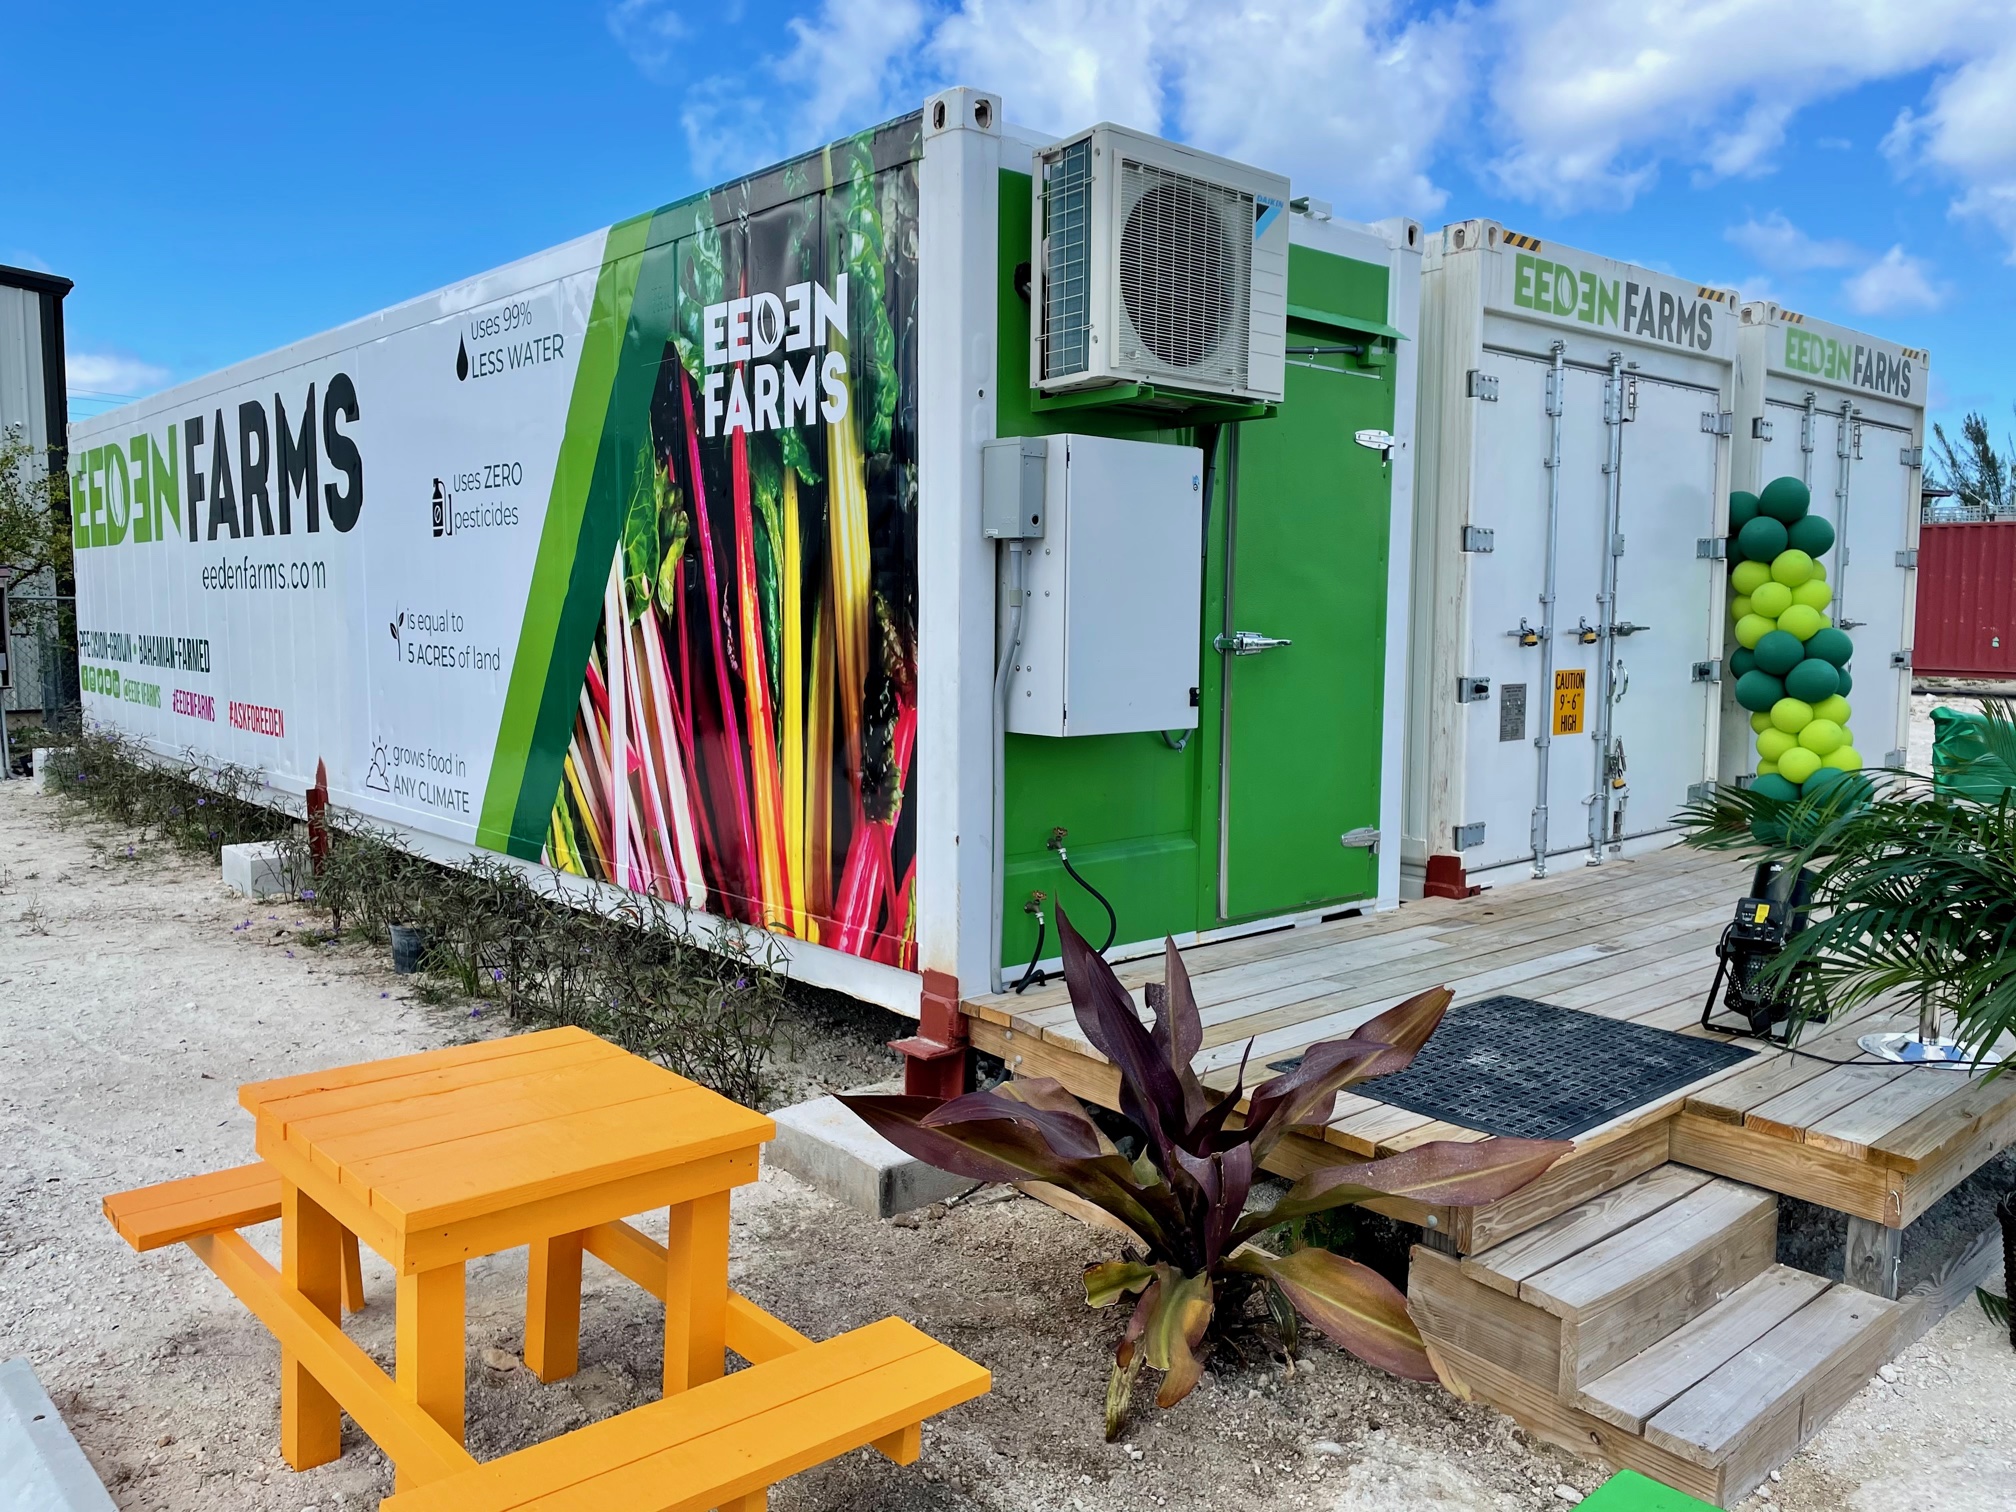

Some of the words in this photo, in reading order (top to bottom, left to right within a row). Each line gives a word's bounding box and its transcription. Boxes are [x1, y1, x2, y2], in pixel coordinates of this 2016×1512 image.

[471, 315, 501, 340] uses
[503, 300, 533, 332] 99%
[703, 272, 849, 367] EEDEN
[1513, 253, 1620, 329] EEDEN
[1623, 281, 1713, 351] FARMS
[471, 348, 504, 379] LESS
[507, 333, 564, 370] WATER
[1784, 327, 1852, 383] EEDEN
[1852, 345, 1911, 399] FARMS
[704, 351, 849, 438] FARMS
[184, 373, 363, 542] FARMS
[453, 472, 481, 493] uses
[483, 462, 523, 489] ZERO
[454, 501, 519, 535] pesticides
[202, 556, 326, 589] eedenfarms.com
[406, 608, 416, 630] is
[417, 609, 449, 636] equal
[451, 611, 464, 632] to
[407, 643, 415, 663] 5
[416, 644, 456, 668] ACRES
[458, 646, 471, 669] of
[473, 647, 501, 671] land
[1555, 672, 1586, 690] CAUTION
[229, 700, 285, 738] #ASKFOREEDEN
[1560, 714, 1577, 732] HIGH
[392, 746, 425, 769] grows
[427, 749, 452, 775] food
[455, 754, 466, 778] in
[393, 774, 417, 800] ANY
[418, 781, 470, 813] CLIMATE
